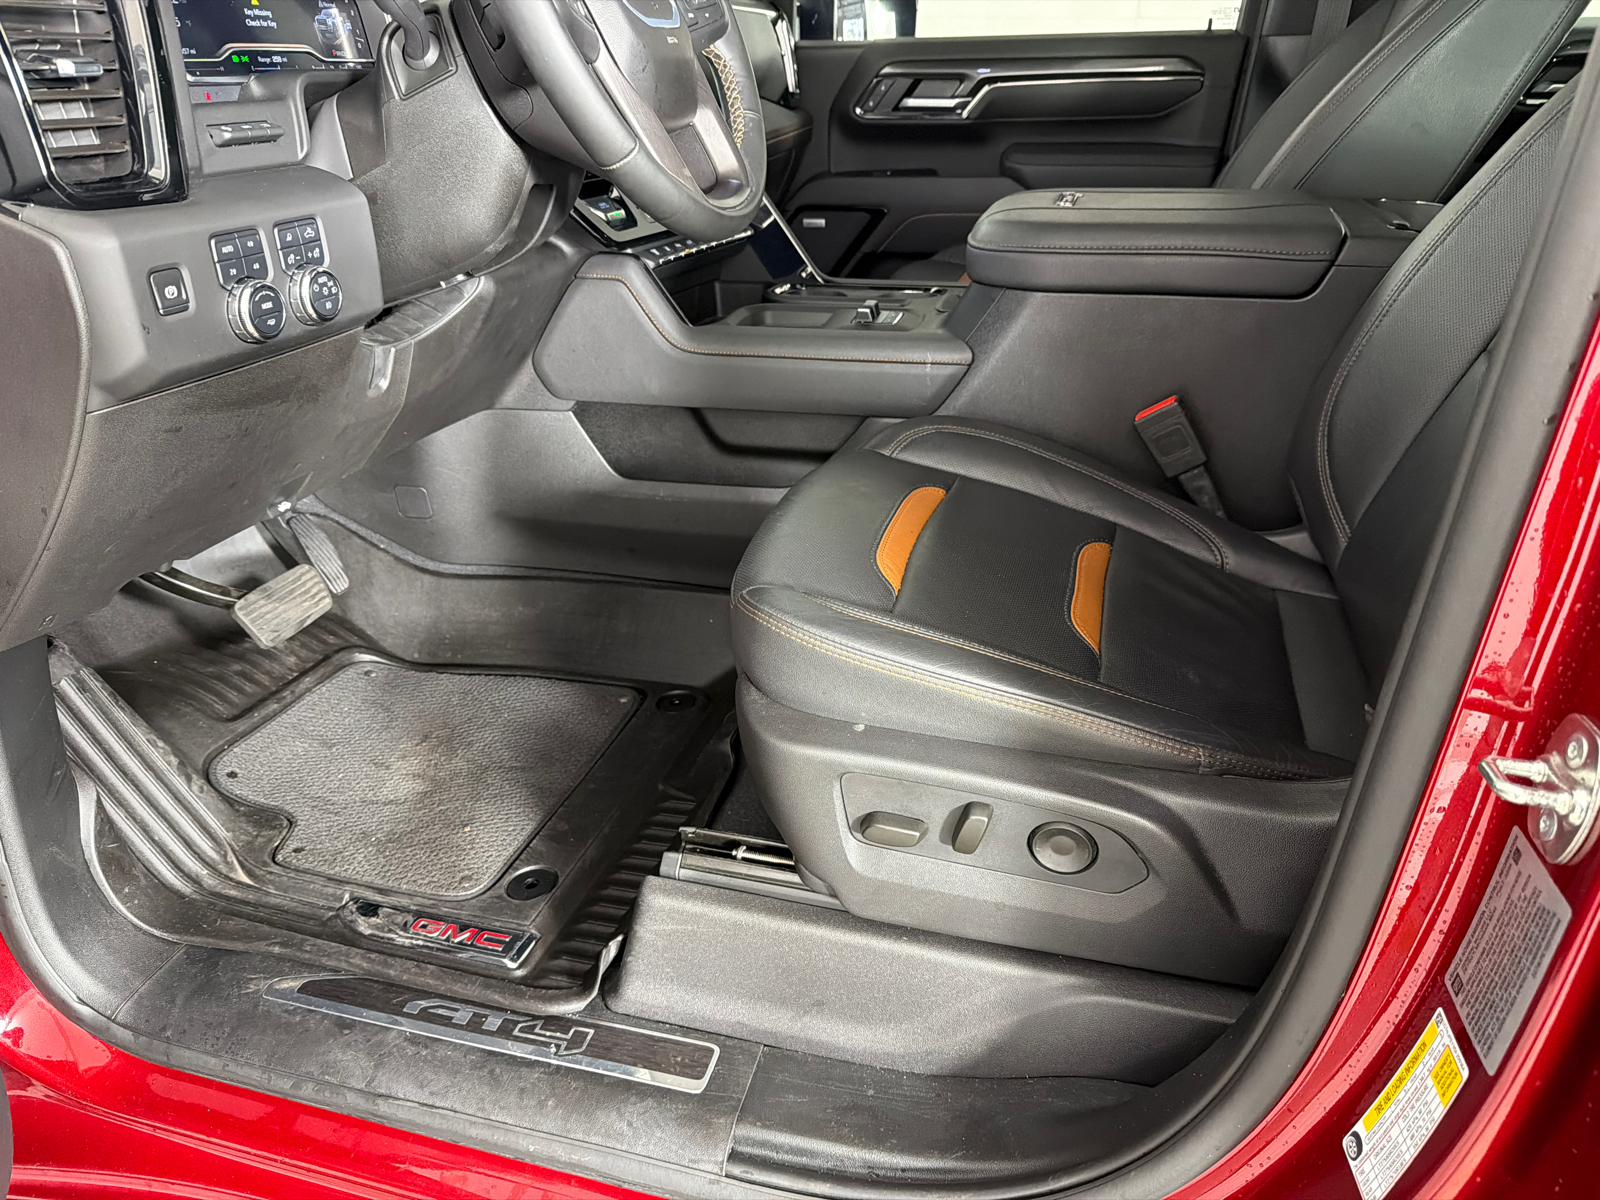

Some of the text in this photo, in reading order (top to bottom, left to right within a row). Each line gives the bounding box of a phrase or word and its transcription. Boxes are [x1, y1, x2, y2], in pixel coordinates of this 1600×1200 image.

[244, 8, 272, 18] Key Missing
[245, 19, 261, 27] Check
[268, 20, 277, 29] Key
[411, 918, 510, 950] GMC
[403, 999, 595, 1056] AT4
[1375, 1040, 1427, 1116] TIRE AND LOADING INFORMATION
